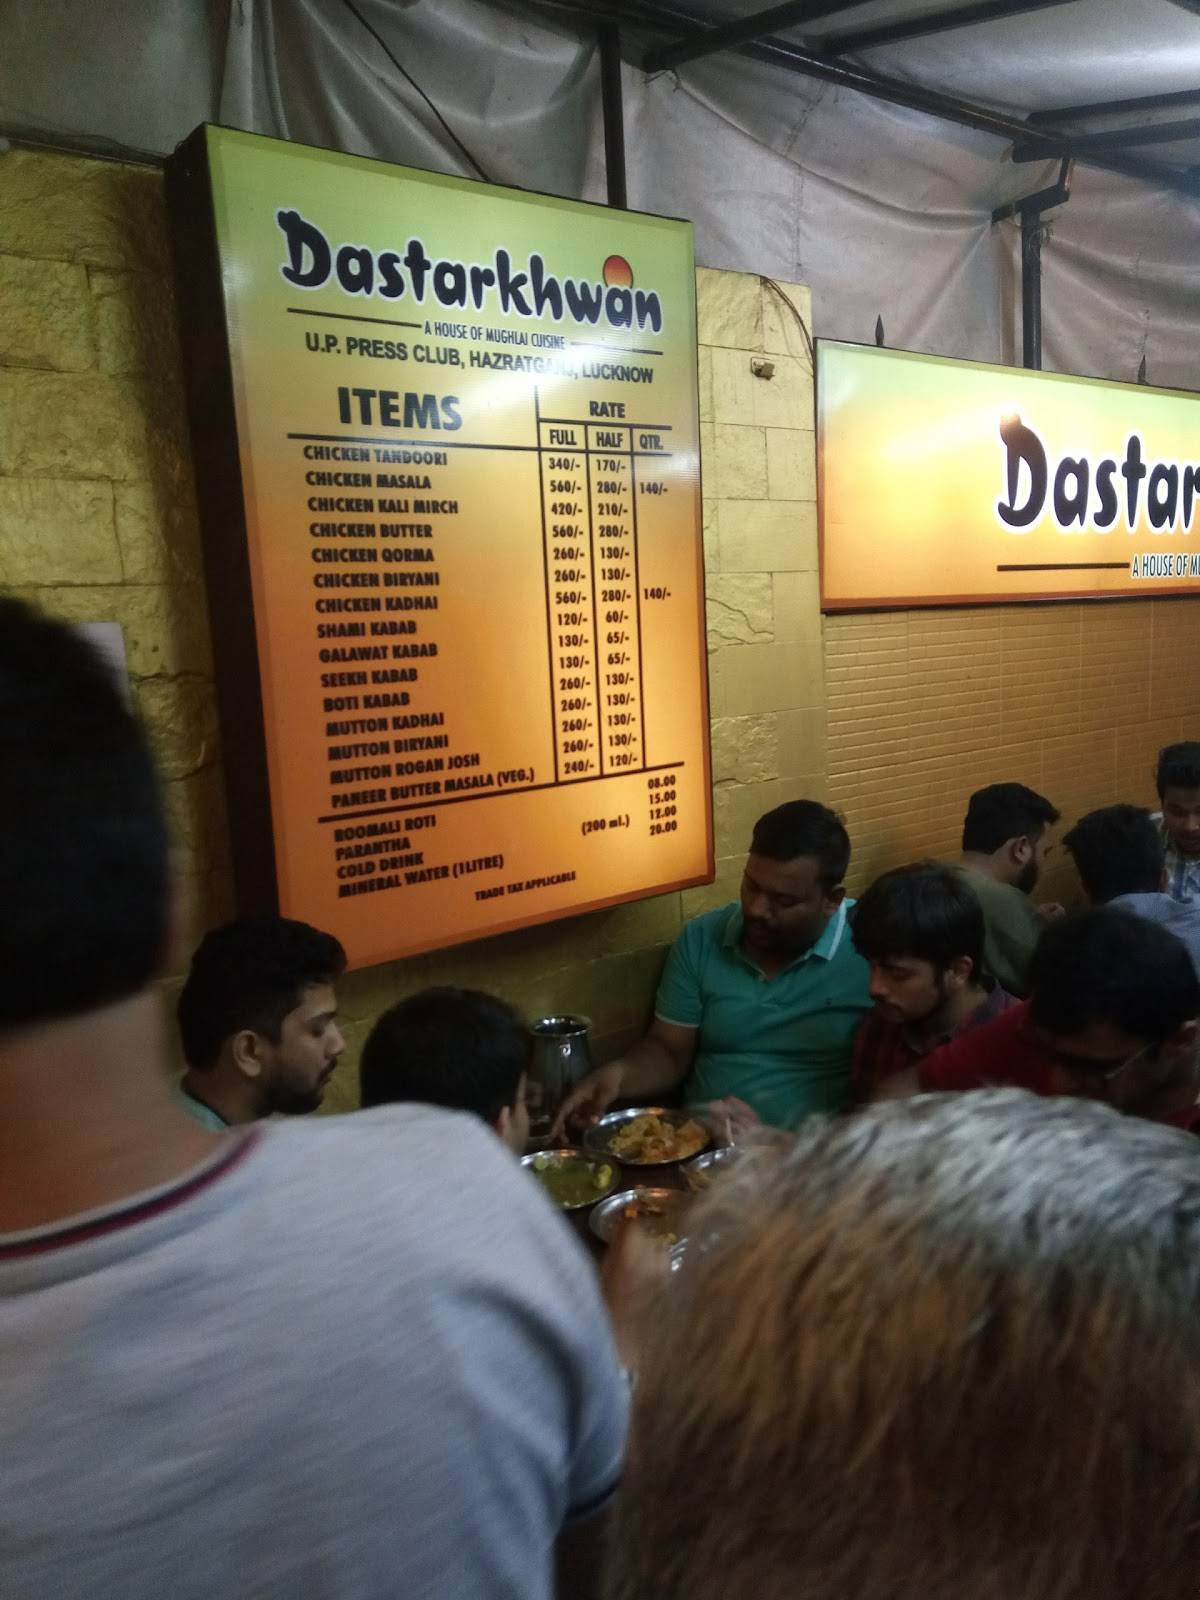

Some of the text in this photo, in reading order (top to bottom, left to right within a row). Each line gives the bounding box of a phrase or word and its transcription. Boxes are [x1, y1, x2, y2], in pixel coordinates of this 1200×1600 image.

[277, 209, 662, 332] Dastarkhwan
[424, 320, 566, 350] A HOUSE OF MUGHLAI CUISINE
[305, 332, 341, 354] U.P.
[346, 336, 408, 361] PRESS
[413, 343, 466, 369] CLUB,
[583, 362, 653, 384] LUCKNOW
[338, 386, 626, 431] ITEMS RATE
[549, 429, 664, 450] FULL HALF QTR.
[303, 445, 448, 465] CHICKEN TANDOORI
[549, 457, 581, 471] 340/-
[597, 459, 626, 473] 170/-
[997, 411, 1200, 529] Dastar
[305, 471, 432, 489] CHICKEN MASALA
[550, 480, 582, 494] 560/-
[597, 481, 627, 495] 280/-
[640, 482, 668, 495] 140/-
[308, 497, 459, 514] CHICKEN KALI MIRCH
[551, 503, 583, 516] 420/-
[598, 503, 628, 516] 210/-
[309, 522, 433, 538] CHICKEN BUTTER
[552, 525, 584, 538] 560/-
[599, 525, 629, 538] 280/-
[312, 548, 434, 563] CHICKEN QORMA
[553, 547, 585, 560] 260/-
[600, 547, 630, 559] 130/-
[1132, 556, 1139, 577] A
[1143, 555, 1173, 577] HOUSE
[1176, 555, 1188, 577] OF
[313, 572, 440, 588] CHICKEN BIRYANI
[554, 570, 586, 582] 260/-
[601, 568, 631, 581] 130/-
[555, 591, 587, 605] 560/-
[602, 589, 631, 603] 280/-
[644, 587, 671, 600] 140/-
[315, 596, 438, 613] CHICKEN KADHAI
[557, 613, 588, 626] 120/-
[606, 611, 629, 624] 60/-
[317, 620, 417, 639] SHAMI KABAB
[558, 634, 589, 648] 130/-
[607, 631, 630, 644] 65/-
[319, 643, 438, 663] GALAWAT KABAB
[608, 652, 630, 665] 65/-
[559, 656, 590, 669] 130/-
[321, 668, 418, 688] SEEKH KABAB
[560, 677, 591, 691] 260/-
[606, 673, 634, 686] 130/-
[324, 692, 410, 712] BOTI KABAB
[561, 698, 592, 712] 260/-
[607, 693, 635, 706] 130/-
[326, 712, 444, 737] MUTTON KADHAI
[562, 719, 593, 733] 260/-
[608, 713, 636, 727] 130/-
[563, 740, 594, 753] 260/-
[608, 733, 637, 747] 130/-
[328, 734, 449, 761] MUTTON BIRYANI
[564, 760, 595, 774] 240/-
[610, 754, 638, 767] 120/-
[330, 753, 480, 785] MUTTON ROGAN JOSH
[331, 767, 535, 809] PANEER BUTTER MASALA (VEG.)
[649, 790, 676, 805] 15.00
[334, 814, 436, 843] ROOMALI ROTI
[650, 820, 677, 836] 20.00
[335, 837, 411, 861] PARANTHA
[337, 852, 424, 880] COLD DRINK
[338, 875, 401, 899] MINERAL
[405, 865, 449, 885] WATER
[474, 871, 577, 901] TRADE TAX APPLICABLE
